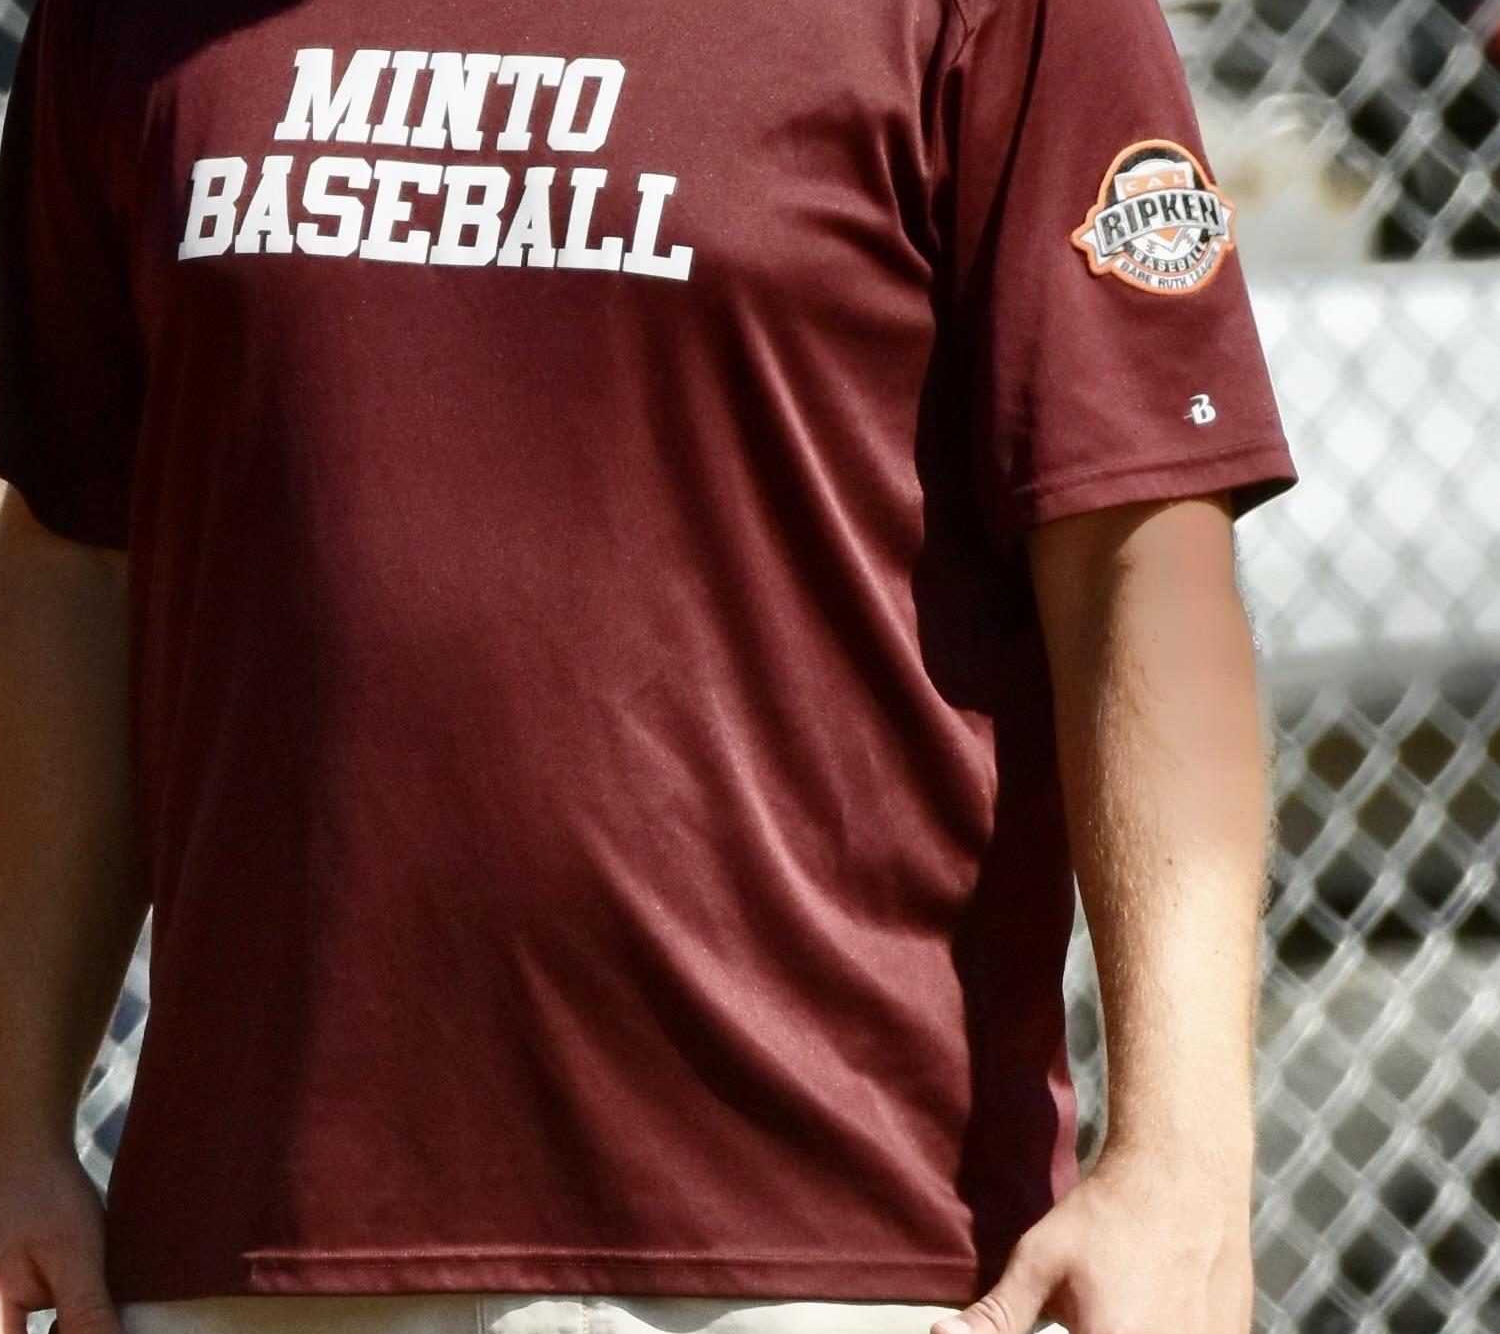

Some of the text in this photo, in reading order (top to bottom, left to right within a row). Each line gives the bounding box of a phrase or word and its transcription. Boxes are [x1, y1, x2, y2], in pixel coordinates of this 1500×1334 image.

[274, 47, 626, 153] MINTO
[1125, 172, 1187, 192] CAL
[178, 155, 693, 281] BASEBALL
[1099, 194, 1220, 248] RIPKEN
[1132, 240, 1208, 273] BASEBALL
[1157, 276, 1188, 289] RUTH
